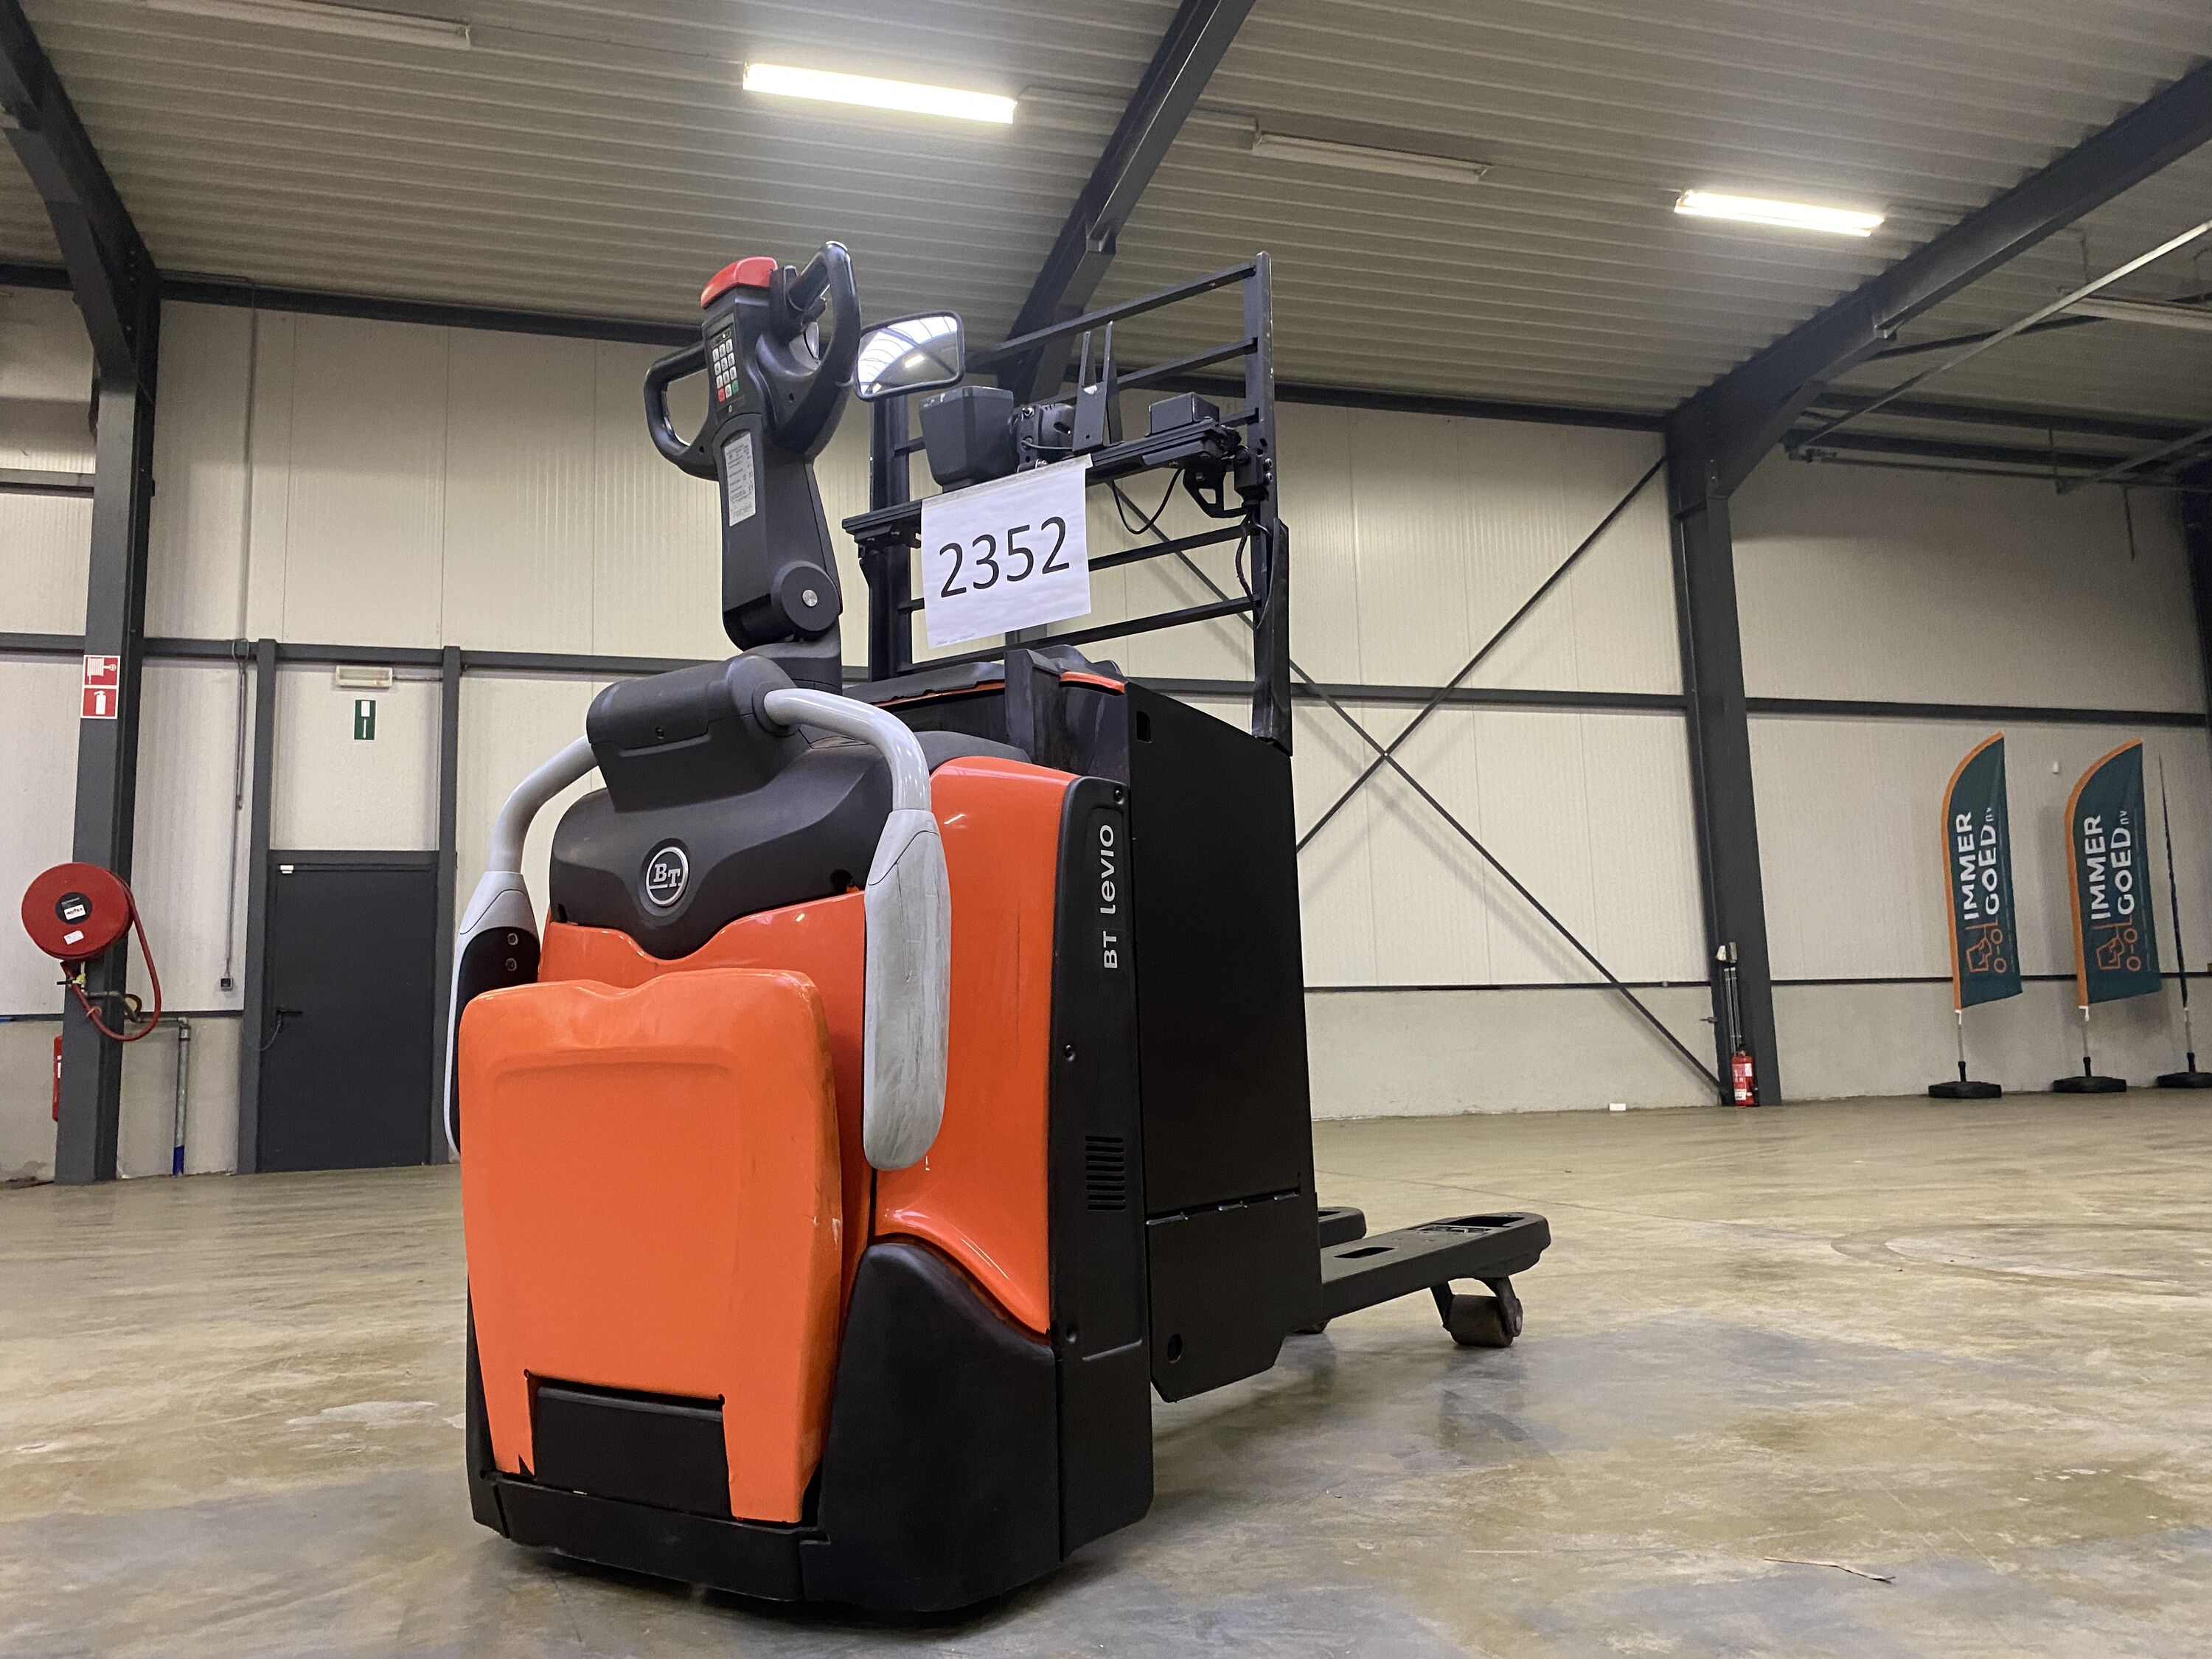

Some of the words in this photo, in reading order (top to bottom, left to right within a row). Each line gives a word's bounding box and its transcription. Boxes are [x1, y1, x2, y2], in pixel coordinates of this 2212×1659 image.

[939, 516, 1070, 598] 2352
[653, 863, 681, 888] BT
[1955, 811, 1980, 920] IMMER
[1978, 824, 2000, 915] GOED
[2084, 814, 2111, 919] IMMER
[2110, 827, 2135, 915] GOED
[1102, 931, 1118, 969] BT
